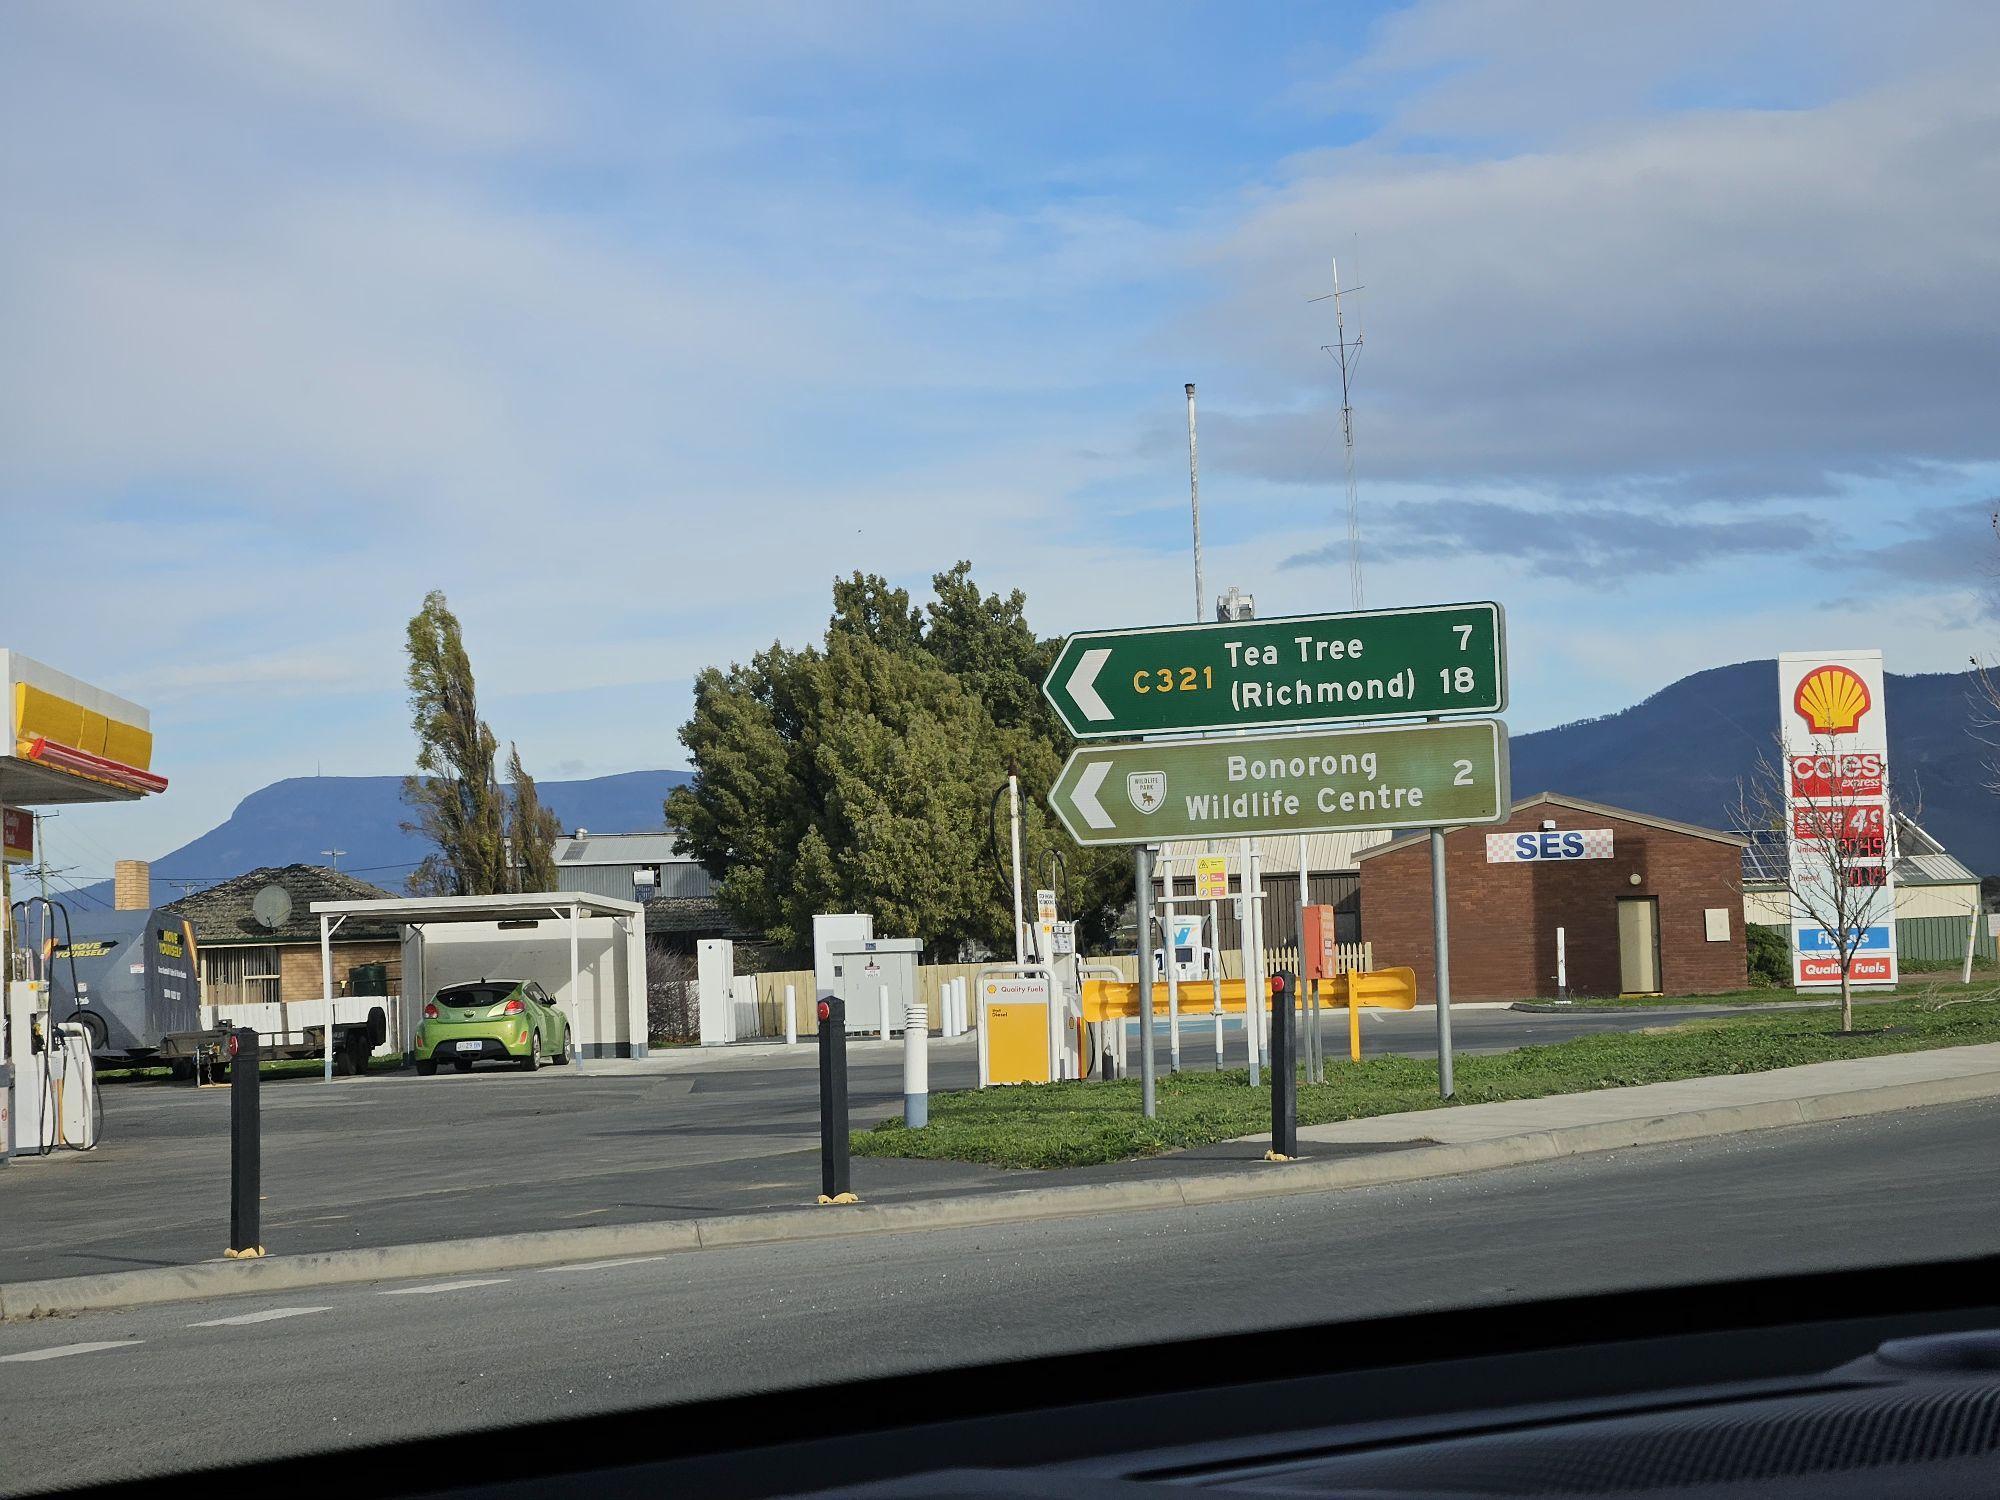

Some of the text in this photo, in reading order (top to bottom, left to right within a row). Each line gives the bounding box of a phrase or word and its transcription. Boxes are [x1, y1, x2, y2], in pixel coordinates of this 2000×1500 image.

[1224, 624, 1473, 668] Tea Tree 7
[1133, 665, 1212, 694] C321
[1231, 666, 1475, 712] (Richmond) 18
[1227, 752, 1474, 786] Bonorong 2
[1793, 754, 1880, 780] coles
[1841, 778, 1880, 788] express
[1185, 783, 1424, 821] Wildlife Centre
[1515, 832, 1585, 860] SES
[55, 947, 111, 959] YOURSELF
[71, 941, 103, 951] MOVE
[1805, 962, 1886, 976] Qualit Fuels
[1001, 985, 1044, 995] Quality Fuels
